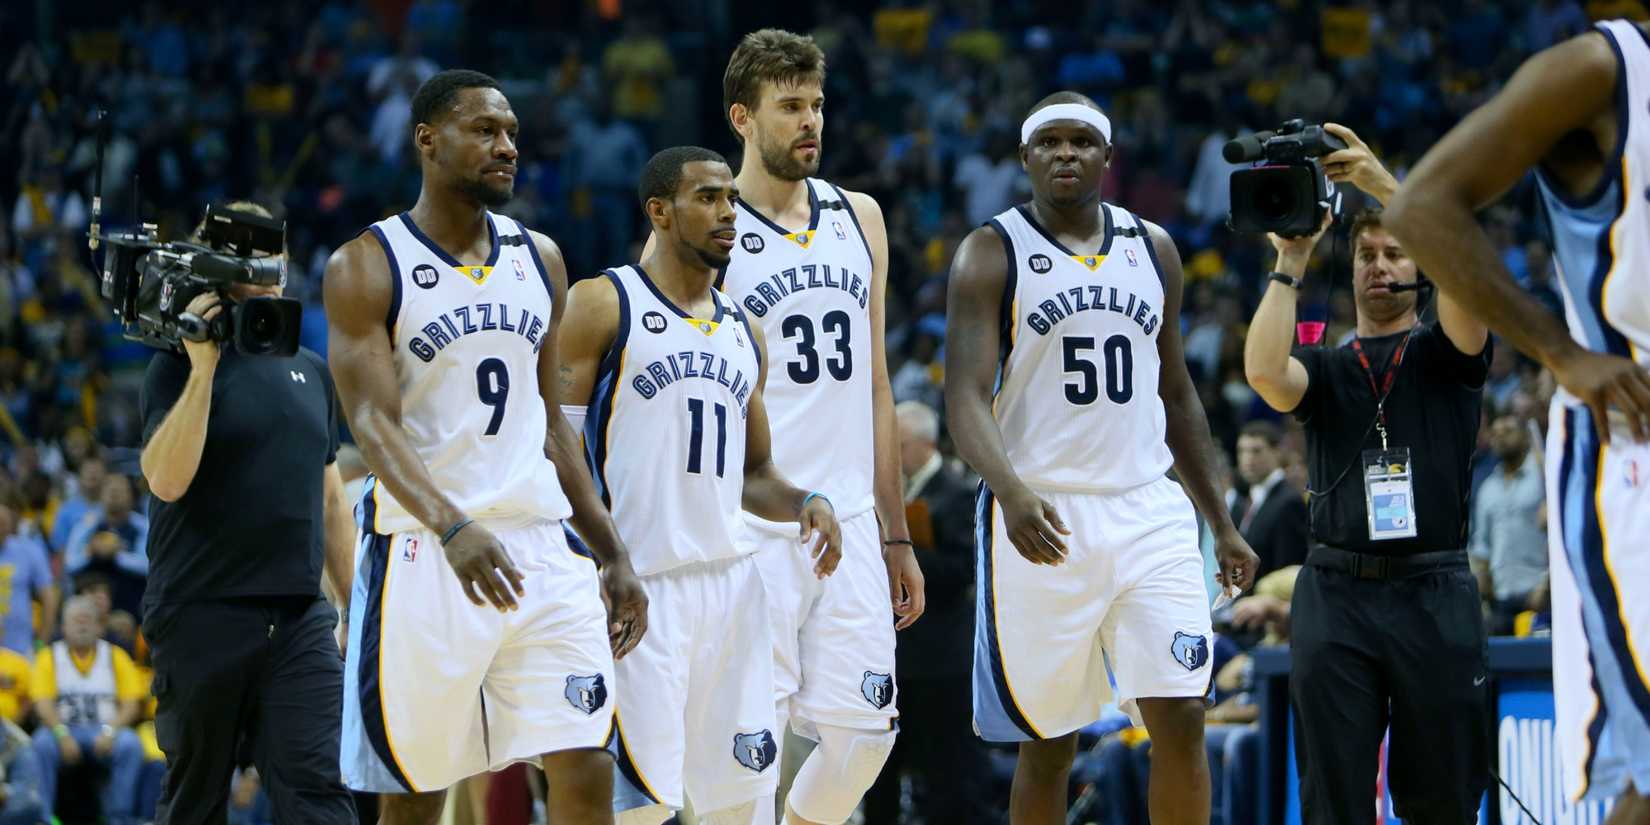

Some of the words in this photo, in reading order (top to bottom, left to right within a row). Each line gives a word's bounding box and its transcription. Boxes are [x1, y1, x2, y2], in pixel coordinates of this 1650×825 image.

[744, 237, 761, 250] DD
[1032, 257, 1050, 270] DD
[415, 268, 436, 284] DD
[743, 264, 868, 318] GRIZZLIES
[645, 315, 666, 329] DD
[1027, 285, 1158, 336] GRIZZLIES
[781, 310, 853, 384] 33
[1062, 334, 1133, 405] 50
[476, 357, 510, 436] 9
[687, 397, 727, 478] 11
